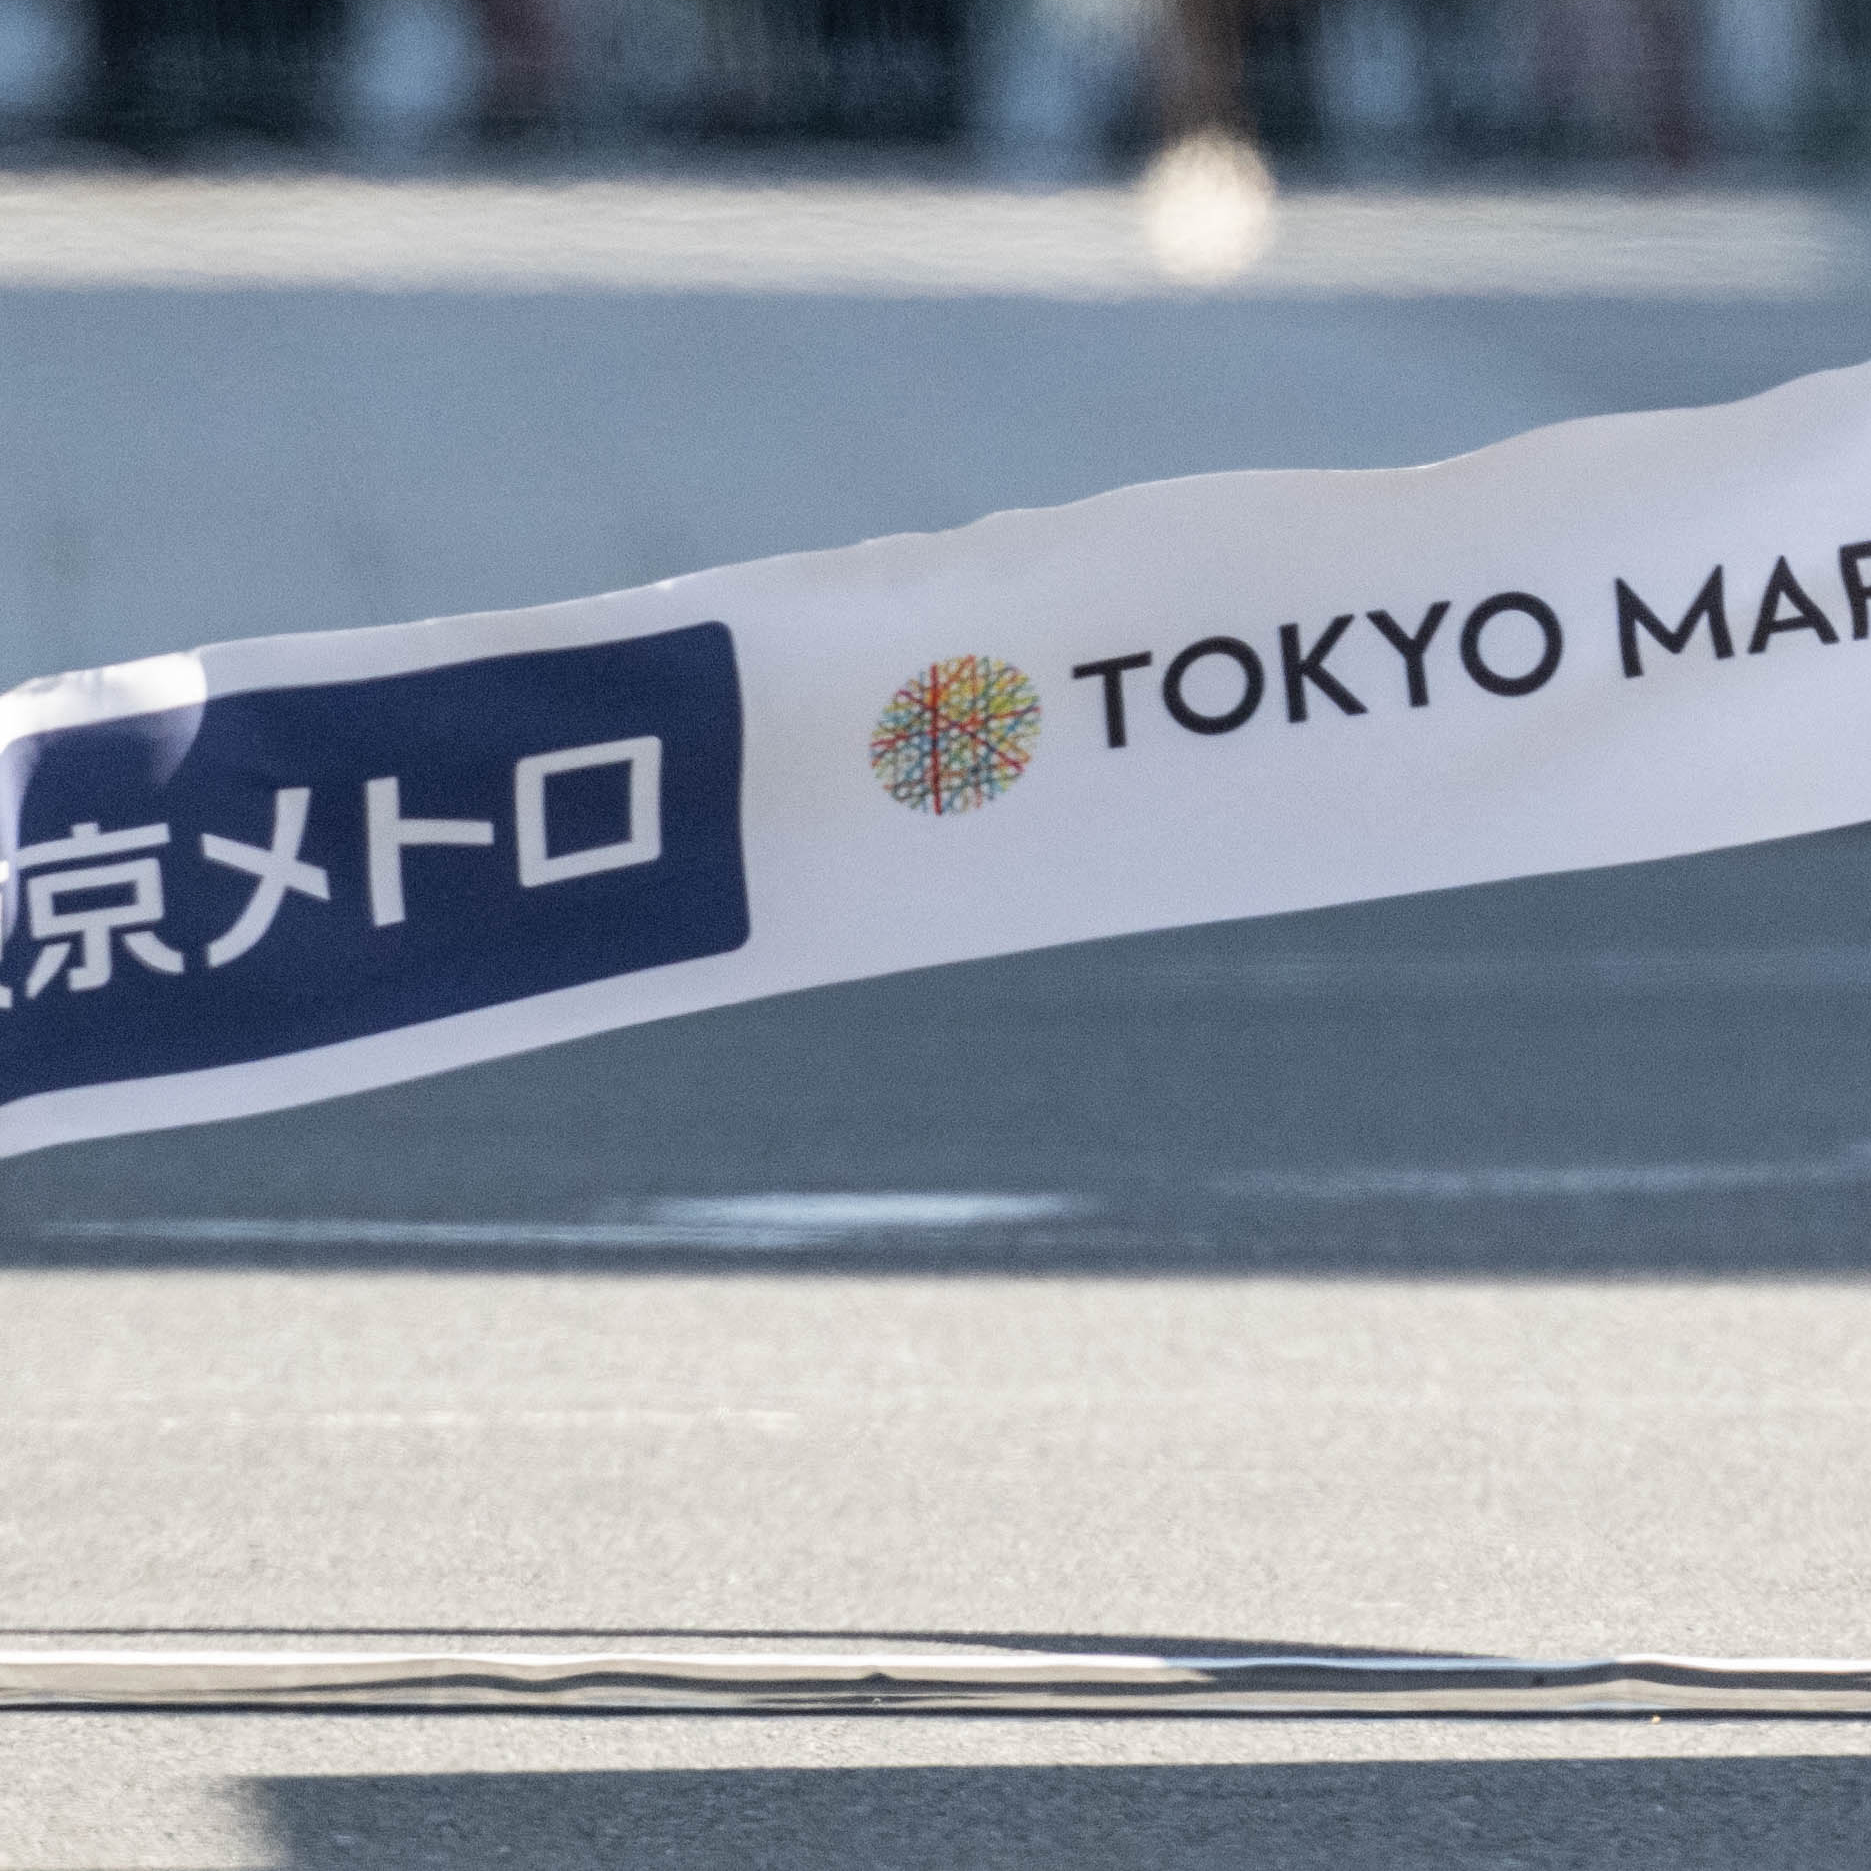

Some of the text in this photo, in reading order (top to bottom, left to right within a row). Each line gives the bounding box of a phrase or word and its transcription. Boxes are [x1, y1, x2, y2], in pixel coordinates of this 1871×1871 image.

[1070, 590, 1565, 750] TOKYO
[0, 735, 662, 1009] 京メトロ
